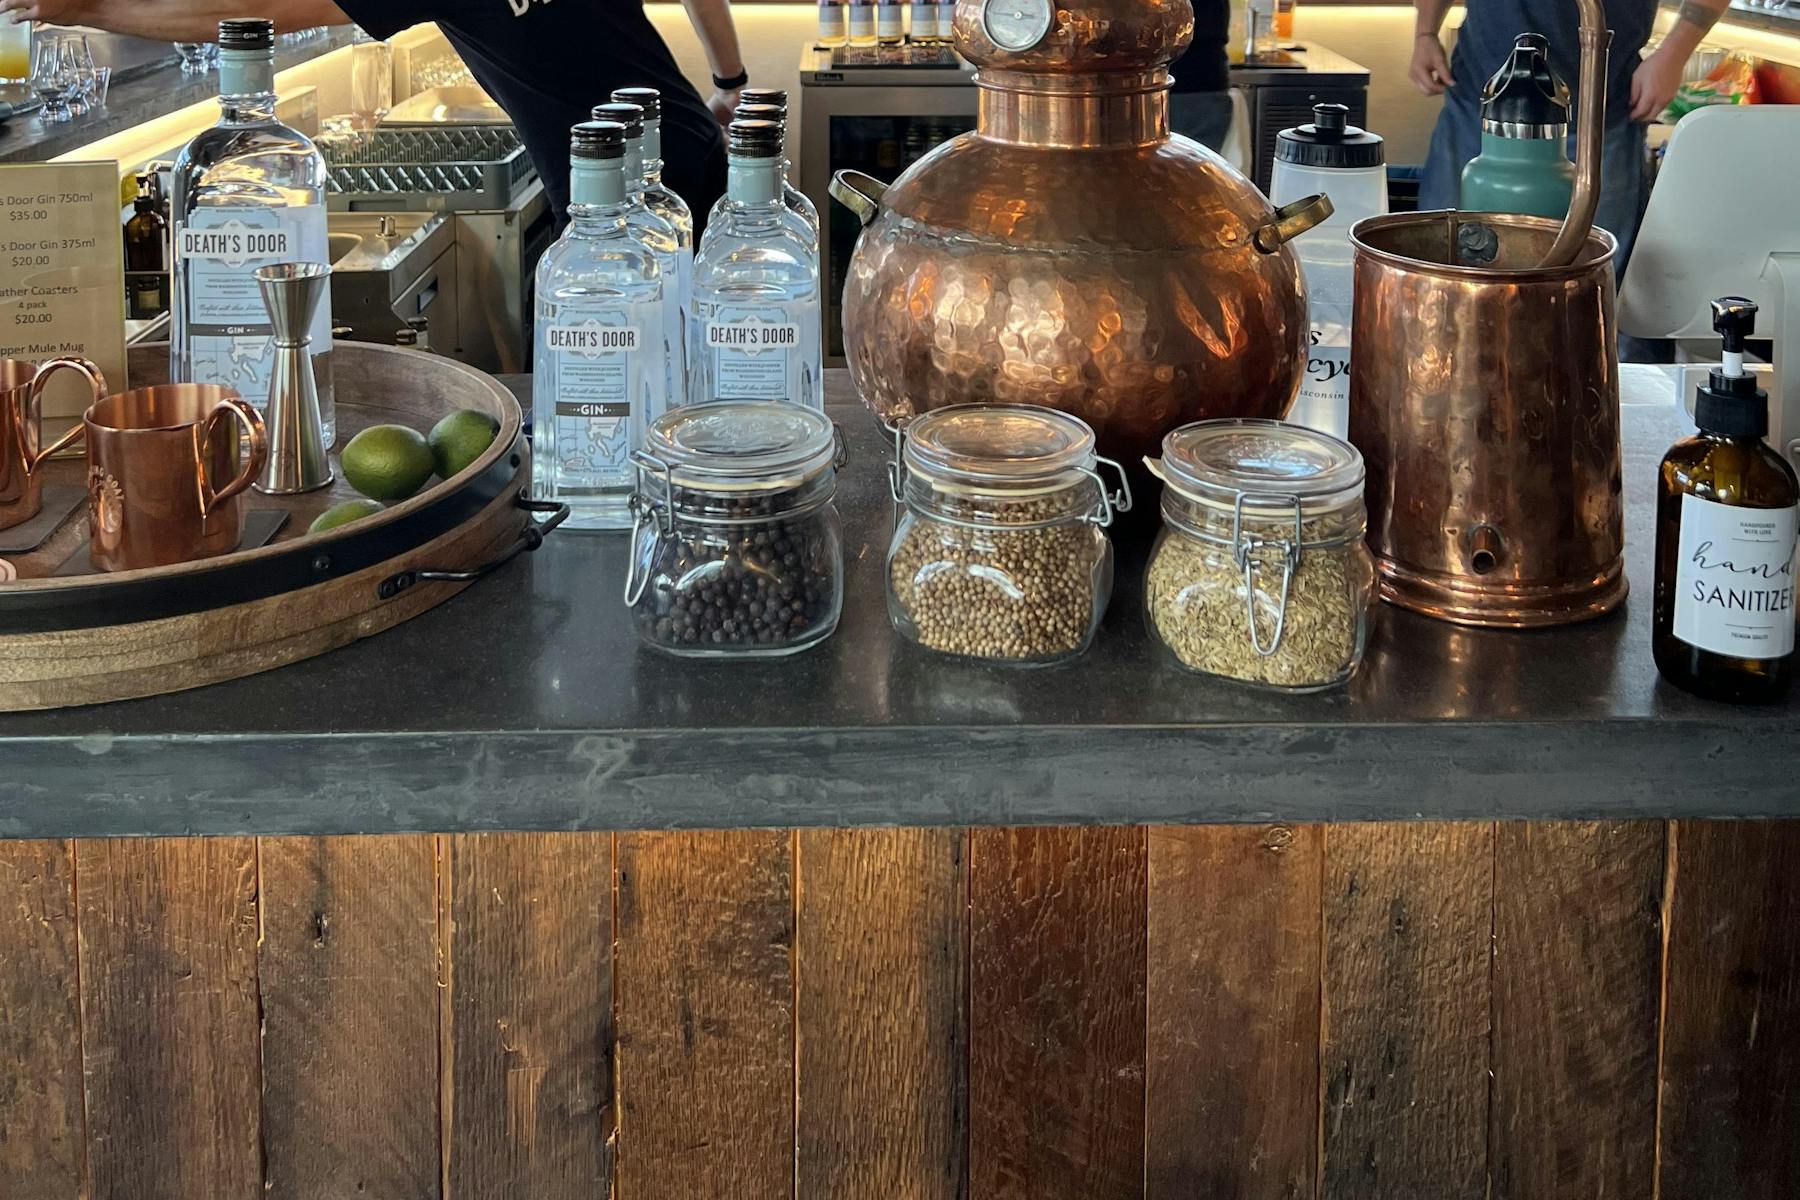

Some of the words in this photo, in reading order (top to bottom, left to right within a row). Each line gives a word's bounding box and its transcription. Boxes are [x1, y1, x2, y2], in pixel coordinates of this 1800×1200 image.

[7, 196, 34, 206] Door
[37, 194, 56, 204] Gin
[59, 192, 93, 203] 750ml
[9, 210, 48, 221] $35.00
[9, 241, 37, 251] Door
[40, 240, 58, 250] Gin
[61, 237, 96, 249] 375ml
[185, 234, 241, 253] DEATH'S
[247, 233, 287, 253] DOOR
[12, 255, 50, 267] $20.00
[31, 286, 79, 296] Coasters
[26, 301, 48, 310] pack
[15, 313, 53, 325] $20.00
[226, 326, 245, 335] GIN
[711, 327, 758, 344] DEATH'S
[762, 328, 795, 344] DOOR
[551, 330, 598, 347] DEATH'S
[602, 331, 635, 347] DOOR
[28, 343, 57, 354] Mule
[60, 342, 85, 353] Mug
[580, 404, 605, 416] GIN
[1692, 540, 1797, 579] hand
